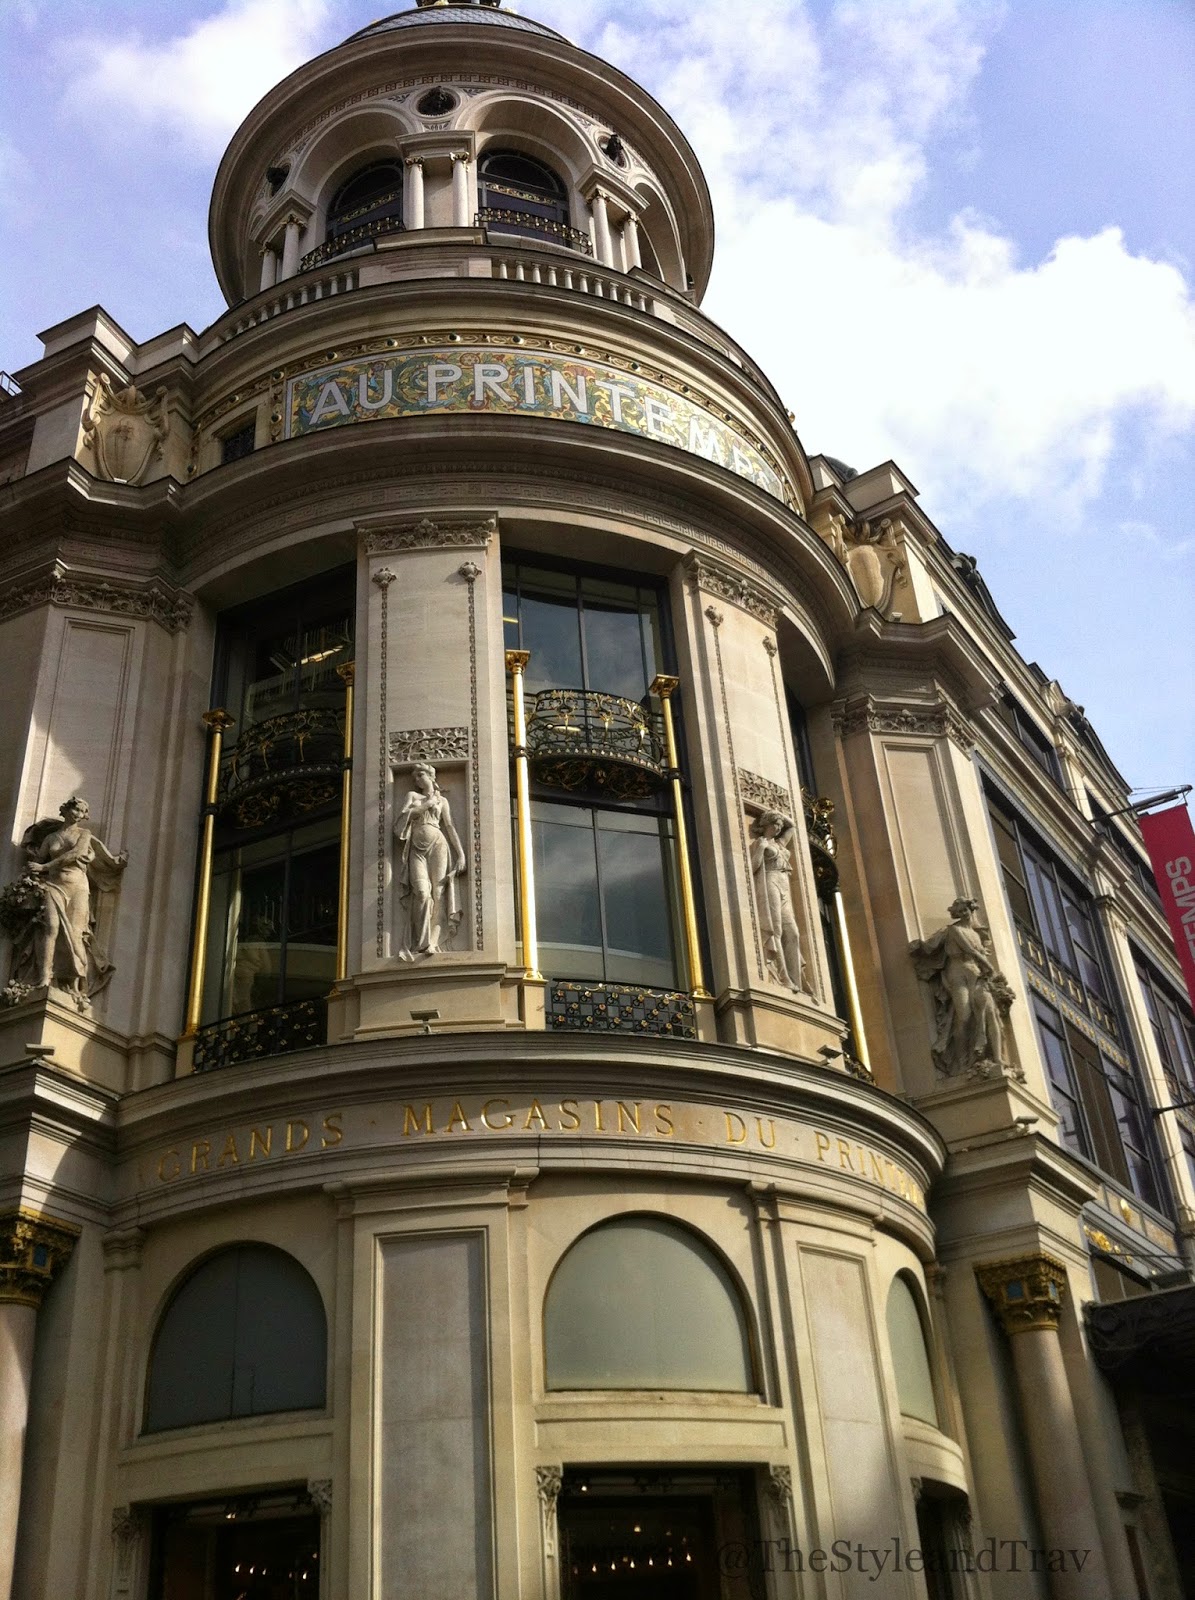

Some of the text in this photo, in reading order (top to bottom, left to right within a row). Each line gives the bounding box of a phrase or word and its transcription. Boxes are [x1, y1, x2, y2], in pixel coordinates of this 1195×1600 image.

[307, 368, 393, 424] AU
[157, 1112, 344, 1183] GRANDS
[402, 1097, 675, 1137] MAGASINS
[722, 1111, 777, 1150] DU
